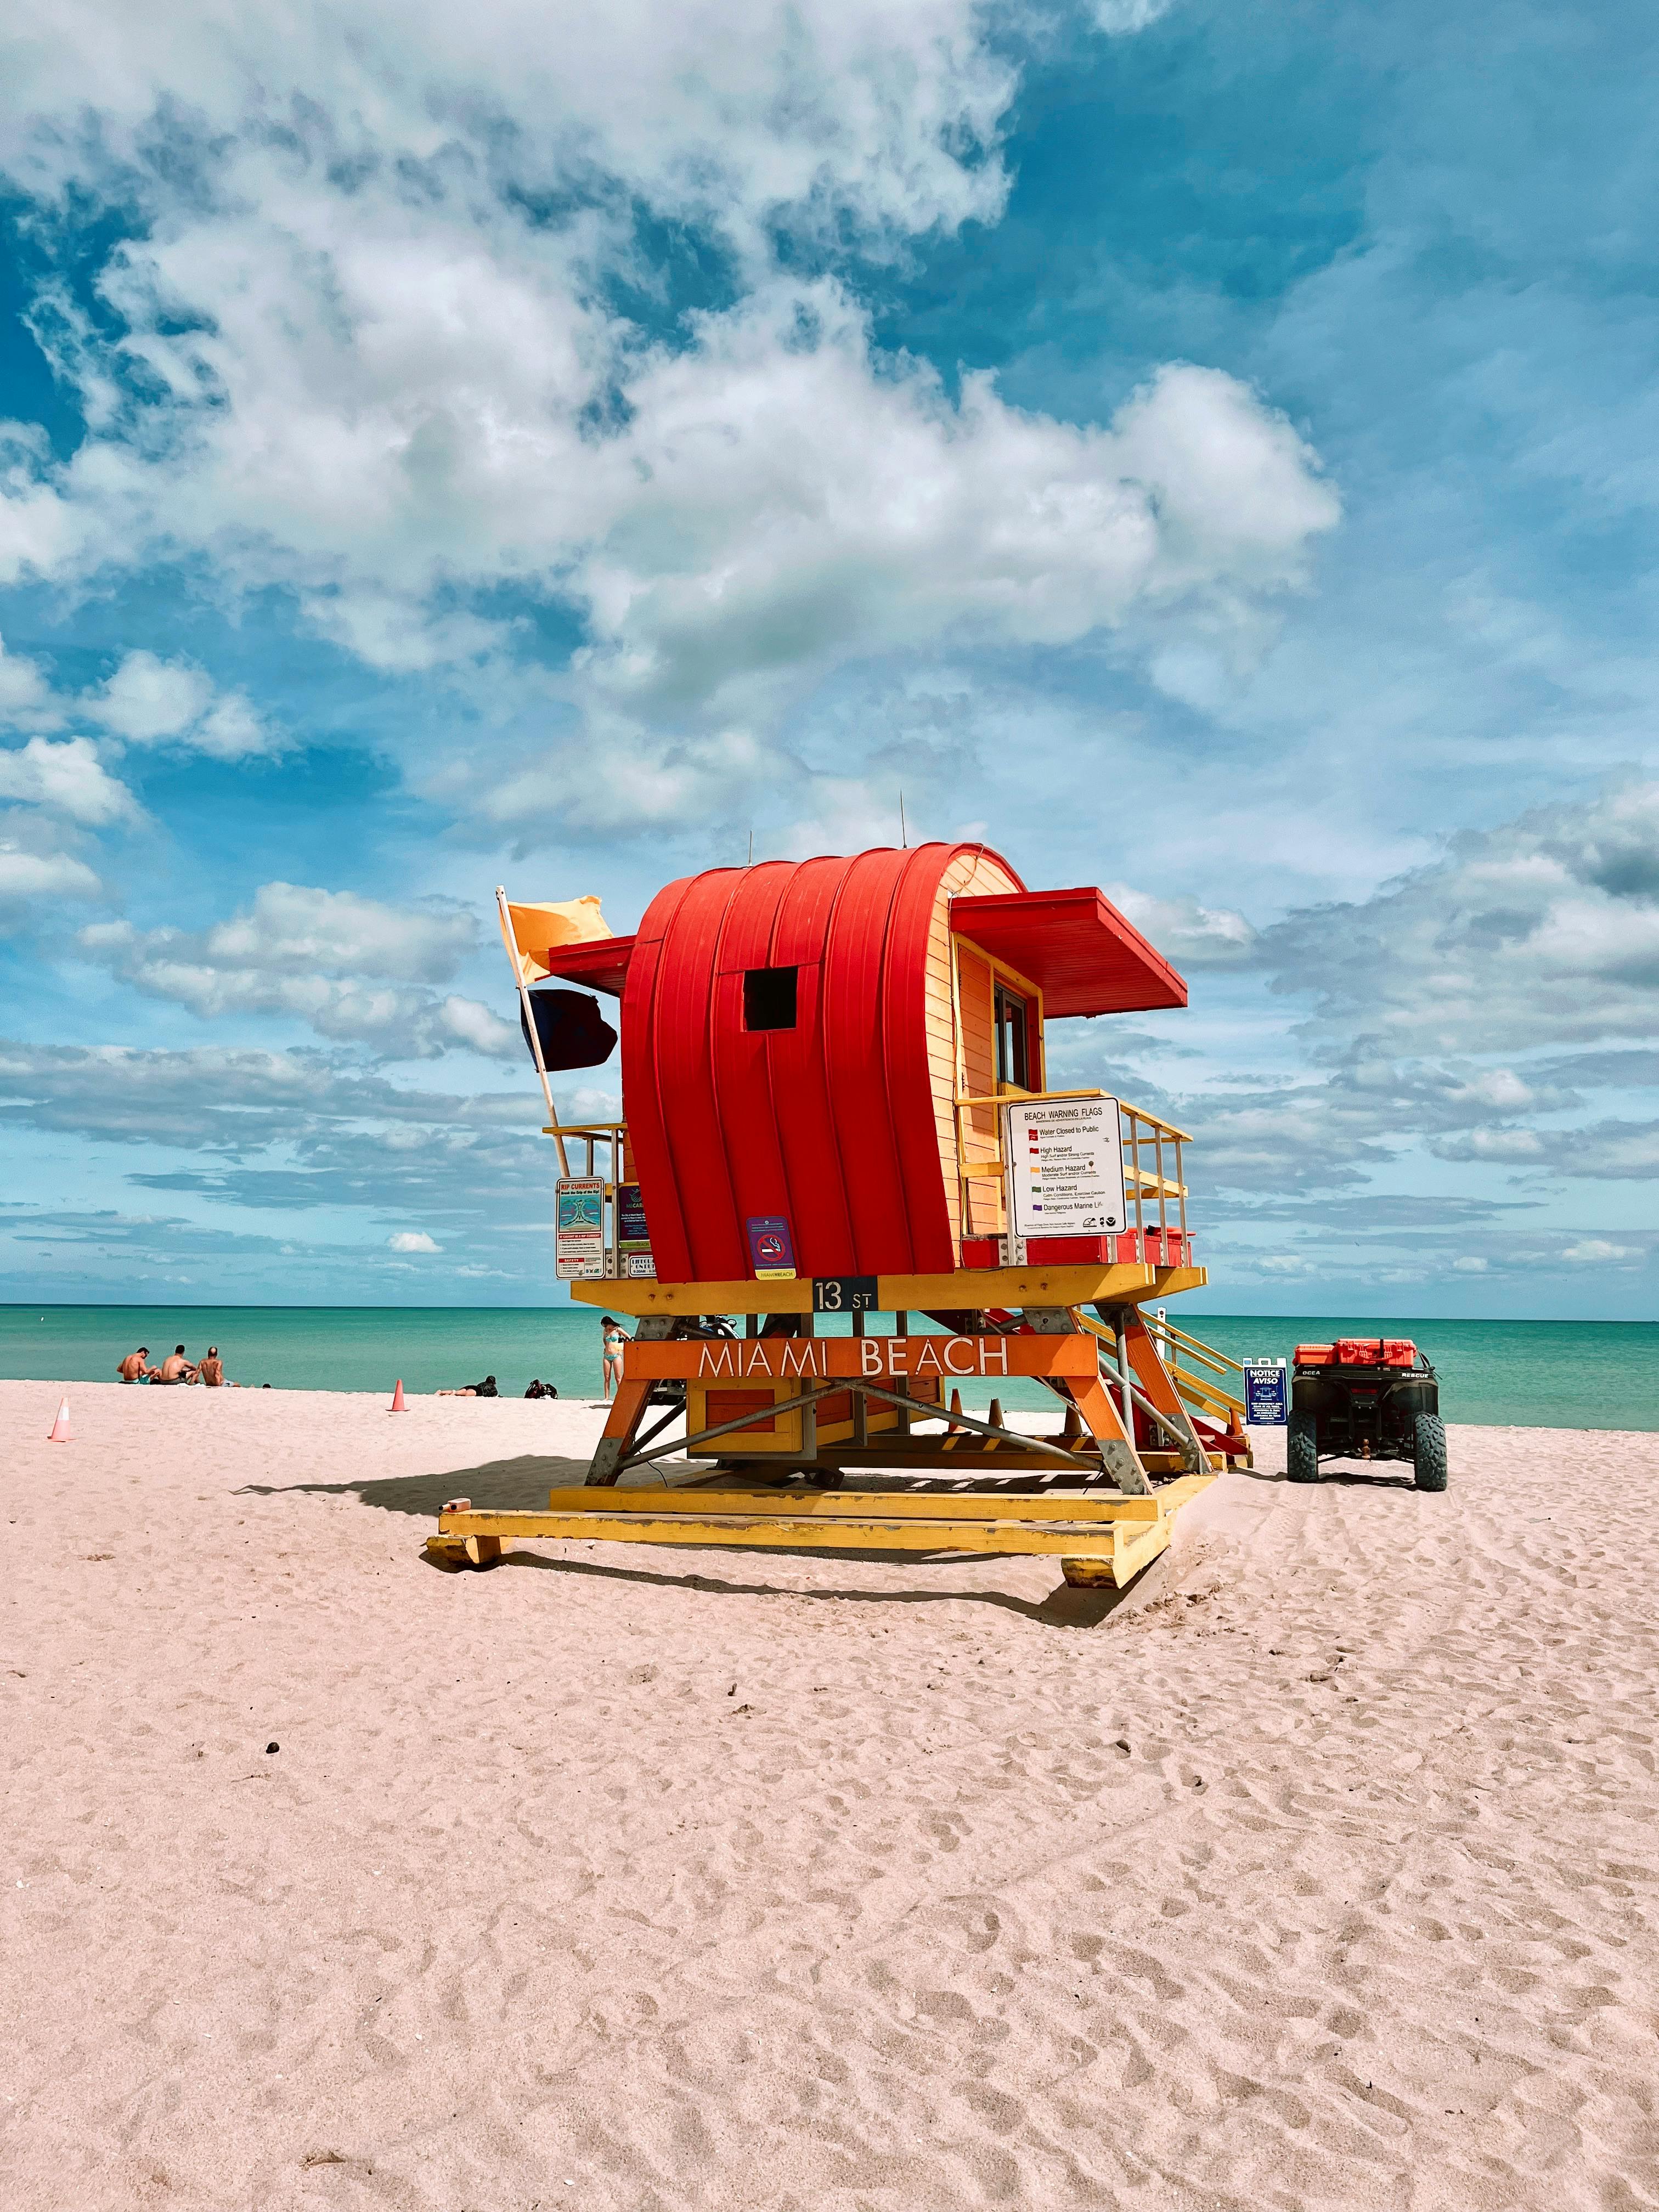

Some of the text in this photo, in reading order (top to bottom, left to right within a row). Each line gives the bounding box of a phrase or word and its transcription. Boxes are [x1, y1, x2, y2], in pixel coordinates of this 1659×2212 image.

[1025, 1108, 1102, 1120] BEACH WARNING FLAGS
[815, 1281, 872, 1310] 13 ST
[698, 1337, 1008, 1377] MIAMI BEACH
